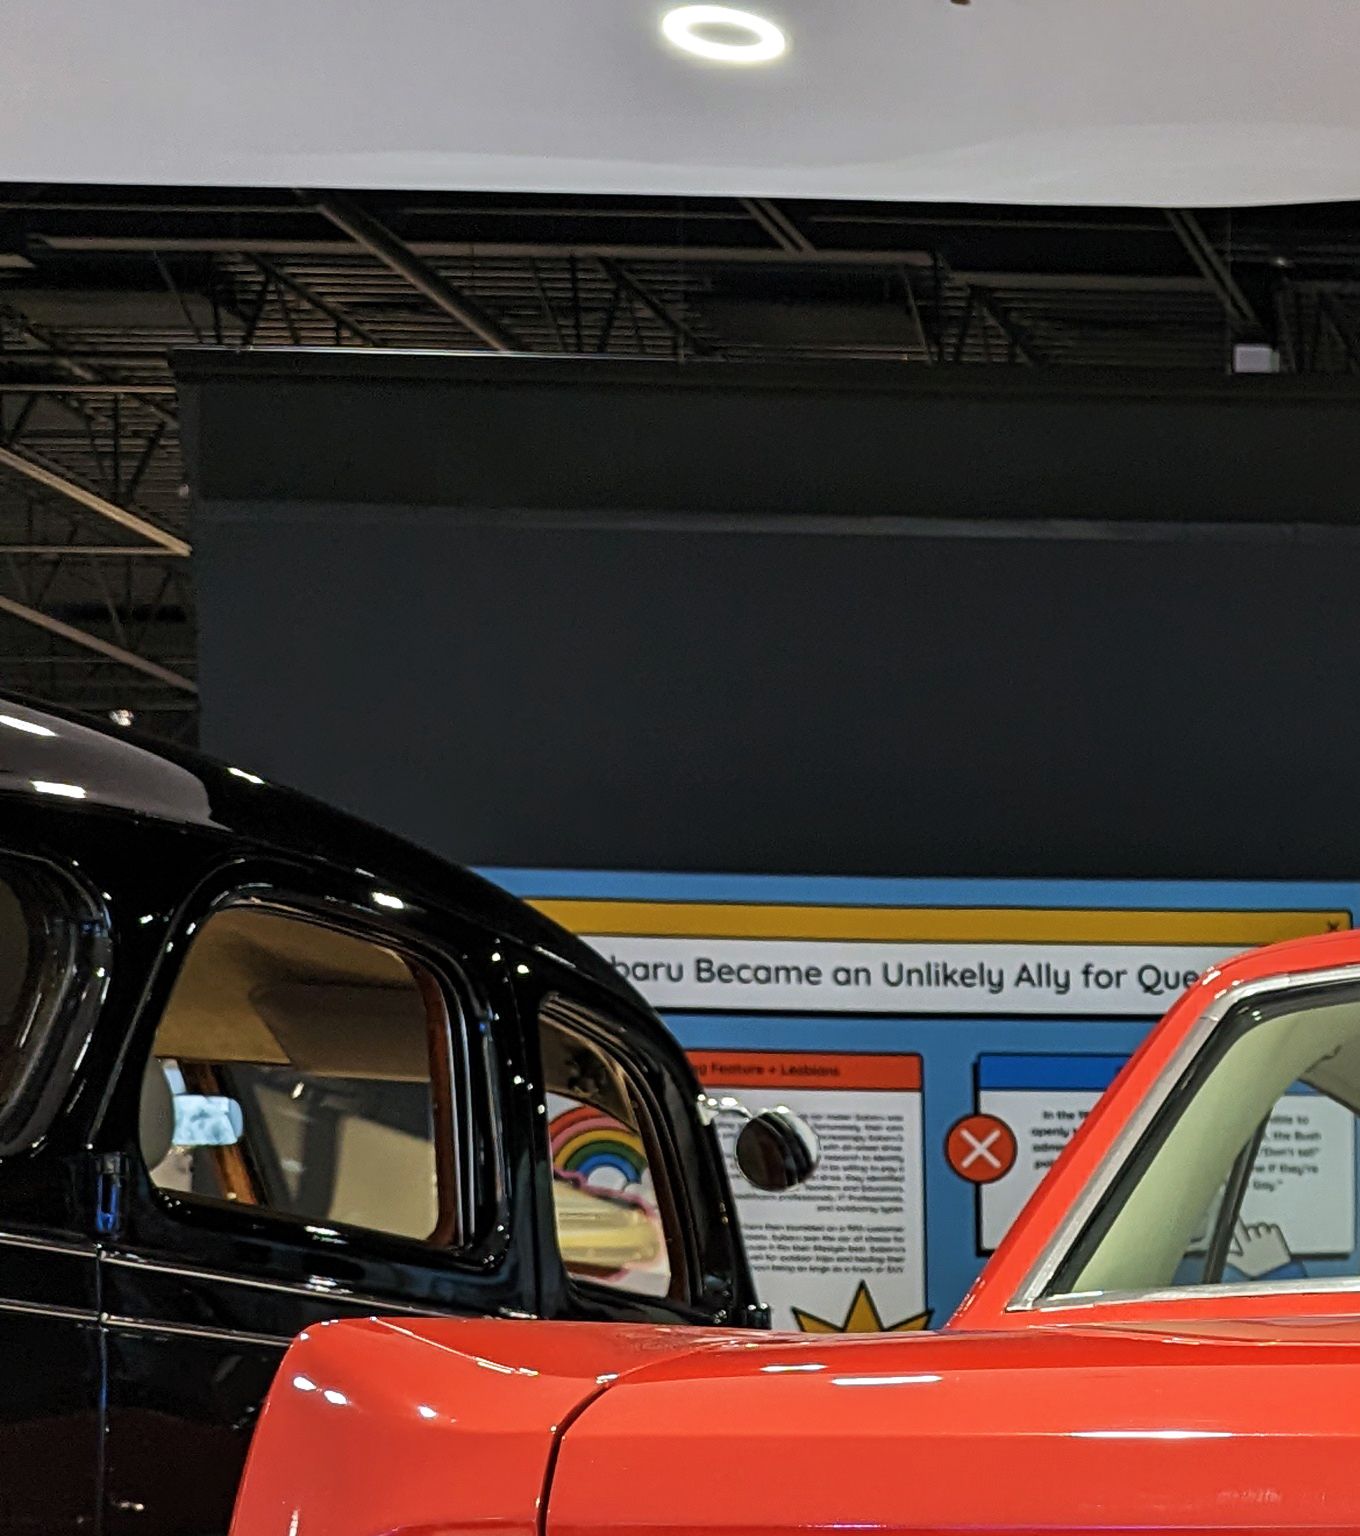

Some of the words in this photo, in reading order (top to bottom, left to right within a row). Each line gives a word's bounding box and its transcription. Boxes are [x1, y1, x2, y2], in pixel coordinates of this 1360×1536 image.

[695, 957, 823, 986] Became
[832, 964, 872, 987] an
[882, 960, 1005, 995] Unlikely
[1013, 961, 1072, 995] Ally
[1080, 962, 1128, 989] for
[781, 1063, 840, 1077] Lesbians
